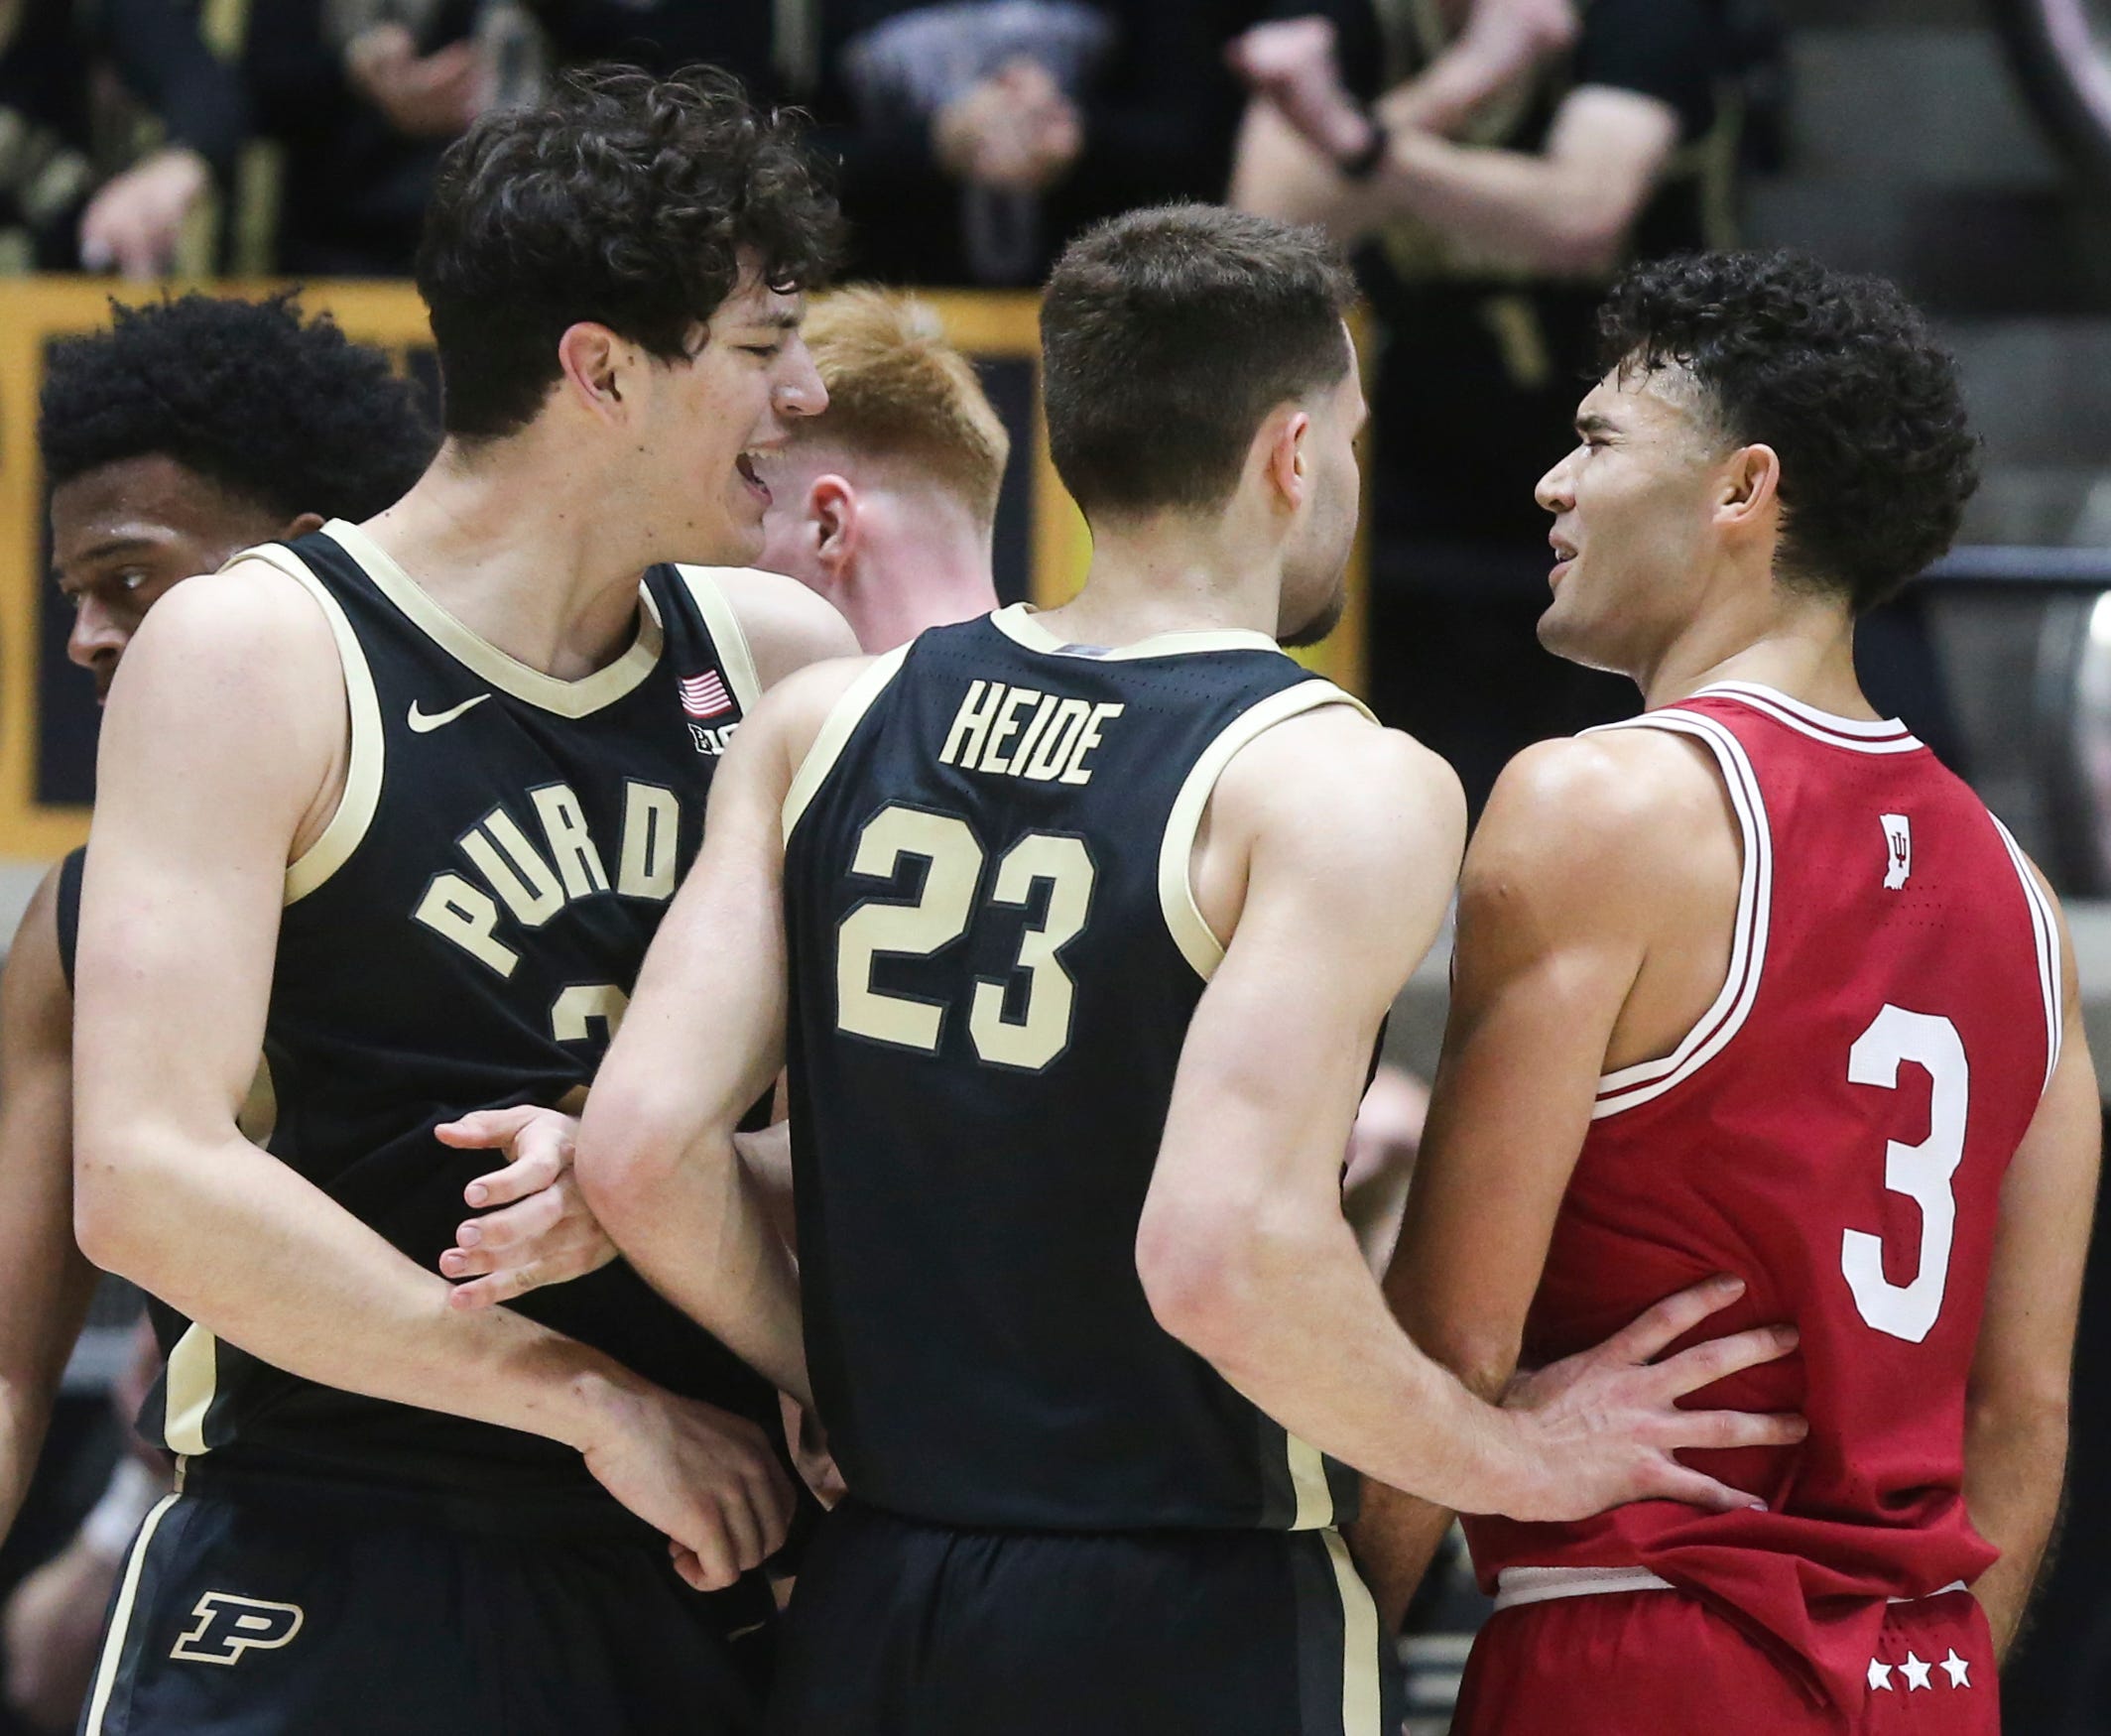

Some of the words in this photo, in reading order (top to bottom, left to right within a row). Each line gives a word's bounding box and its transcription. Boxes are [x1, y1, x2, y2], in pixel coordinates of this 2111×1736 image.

[938, 680, 1125, 785] HEIDE
[411, 778, 681, 979] PURD
[835, 801, 1097, 1073] 23
[1841, 1003, 1970, 1343] 3
[169, 1591, 305, 1666] P
